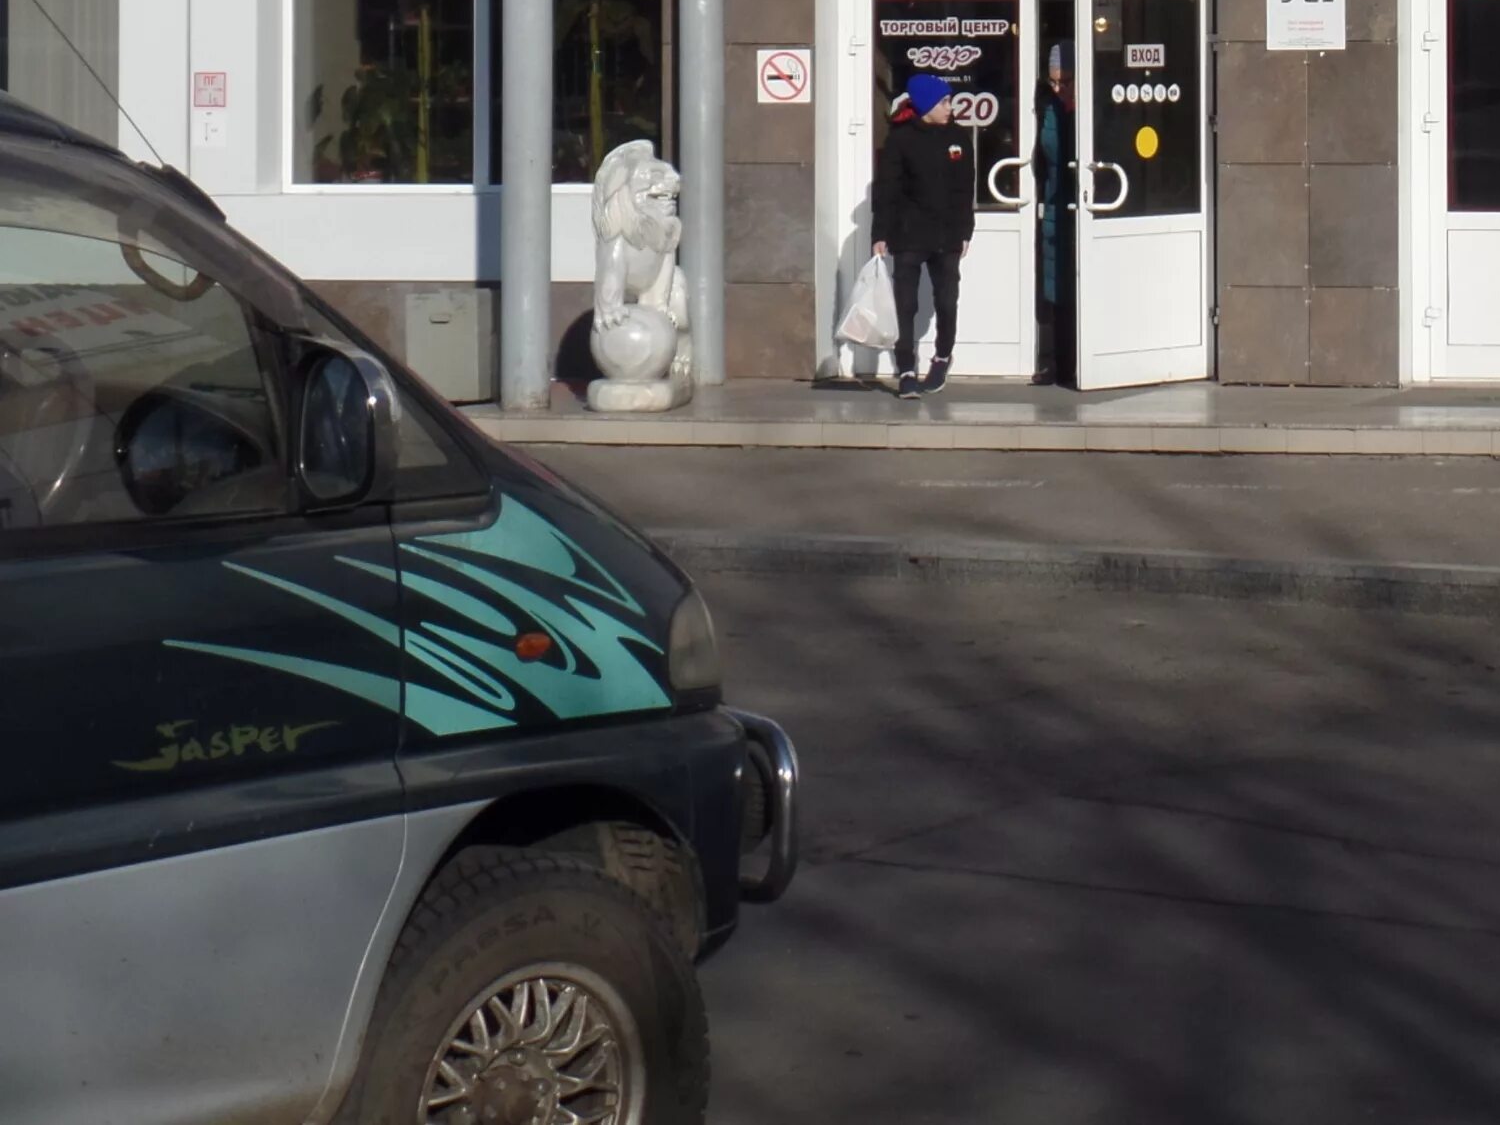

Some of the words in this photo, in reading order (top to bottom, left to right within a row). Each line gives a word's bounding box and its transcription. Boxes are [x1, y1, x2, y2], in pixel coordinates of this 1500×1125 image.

[881, 18, 958, 34] ТОРГОВЫЙ
[962, 20, 1008, 36] ЦЕНТР
[1131, 48, 1161, 64] ВХОД
